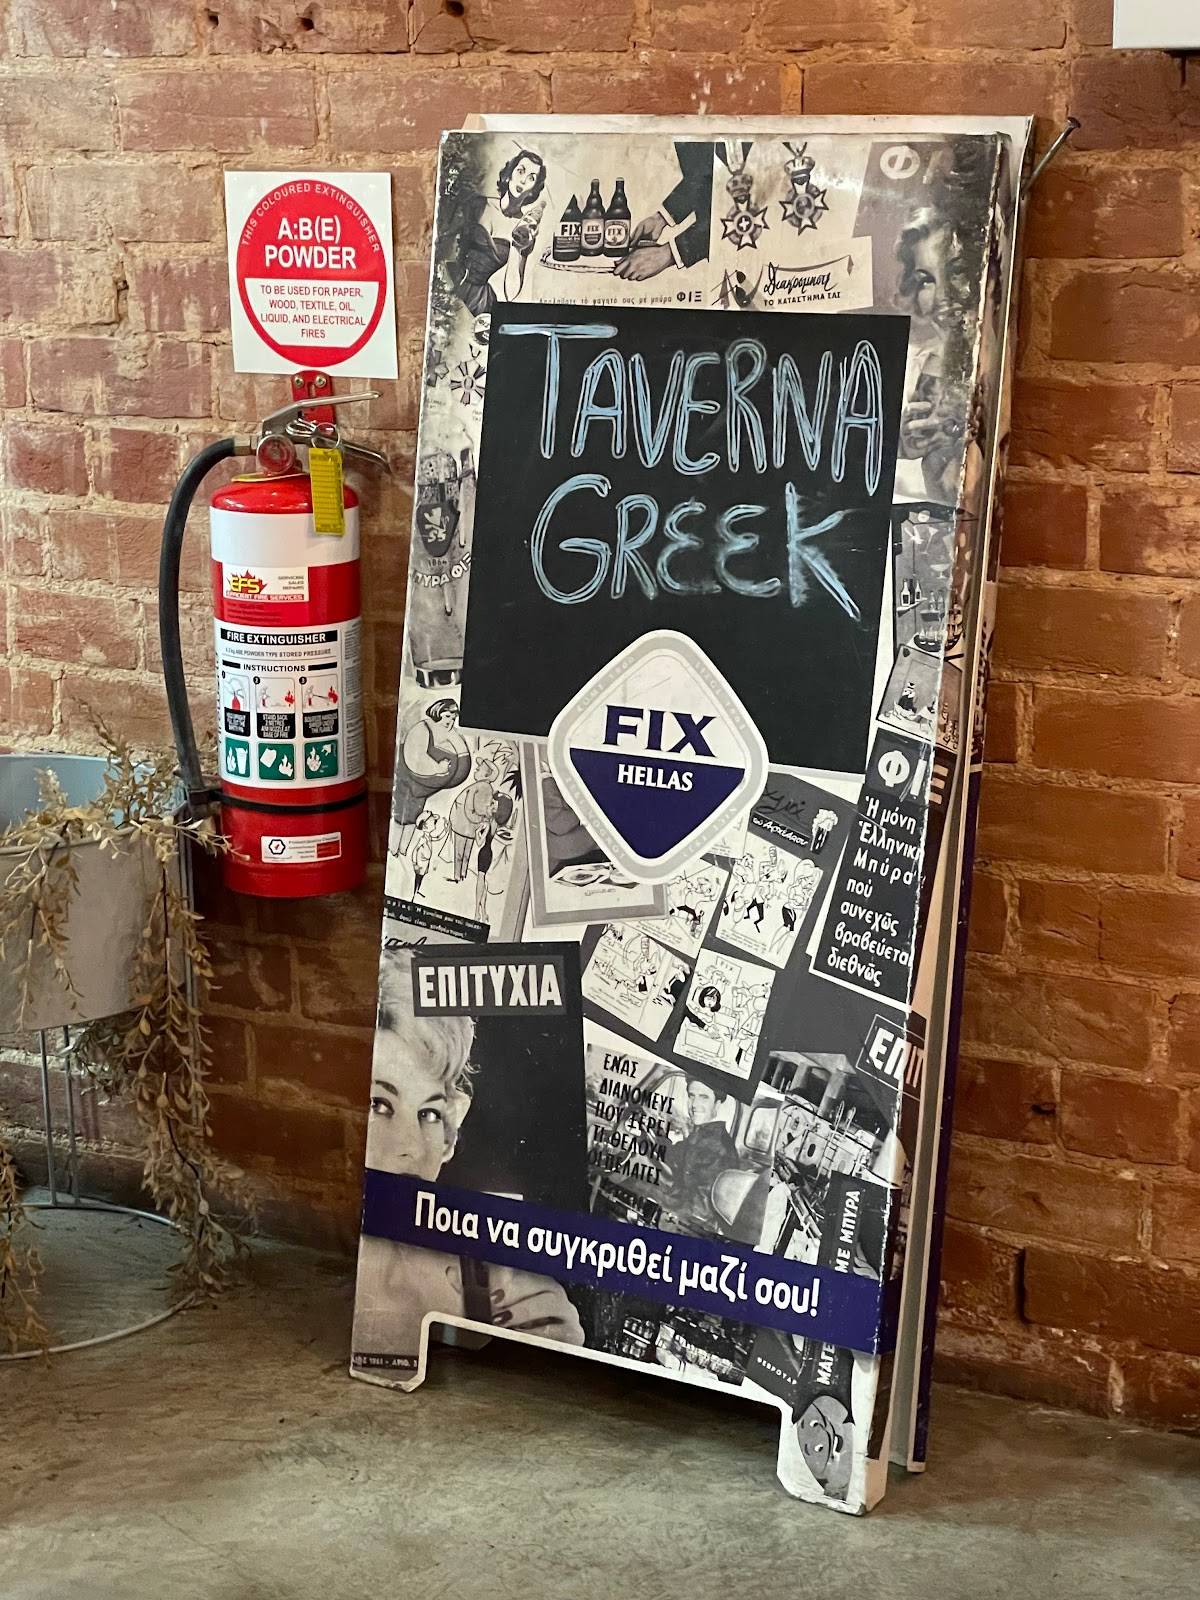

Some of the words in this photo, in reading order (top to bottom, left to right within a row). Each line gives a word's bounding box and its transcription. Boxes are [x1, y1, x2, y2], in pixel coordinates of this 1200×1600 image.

[241, 217, 258, 246] THIS
[256, 182, 311, 217] COLOURED
[315, 183, 380, 252] EXTINGUISHER
[277, 215, 341, 244] A:B(E)
[561, 224, 581, 236] FIX
[264, 244, 357, 270] POWDER
[261, 285, 272, 295] TO
[274, 285, 285, 295] BE
[287, 286, 310, 296] USED
[312, 286, 330, 296] FOR
[332, 287, 364, 298] PAPER,
[676, 290, 703, 303] ΦΙΞ
[269, 299, 298, 311] WOOD,
[301, 300, 337, 312] TEXTILE,
[261, 313, 291, 324] LIQUID,
[293, 314, 310, 324] AND
[312, 315, 366, 326] ELECTRICAL
[301, 328, 326, 339] FIRES
[499, 323, 882, 496] TAVERNA
[531, 473, 862, 621] GREEK
[230, 576, 260, 594] EFS
[226, 631, 245, 642] FIRE
[246, 632, 326, 645] EXTINGUISHER
[243, 663, 306, 673] INSTRUCTIONS
[603, 704, 717, 757] FIX
[617, 763, 693, 792] HELLAS
[880, 807, 916, 835] μόνη
[418, 964, 563, 1008] ΕΠΙΤΥΧΙΑ
[603, 1053, 639, 1079] ΕΝΑΣ
[599, 1077, 675, 1115] ΔΙΑΝΟΜΕΥΣ
[594, 1100, 624, 1124] ΠΟΥ
[611, 1131, 668, 1163] ΘΕΛΟΥΝ
[839, 1190, 860, 1244] ΜΠΥΡΑ
[414, 1190, 479, 1240] Ποια
[487, 1216, 520, 1249] να
[527, 1226, 672, 1282] συγκριθεί
[679, 1254, 748, 1303] μαζί
[755, 1278, 821, 1318] σου!
[834, 1247, 851, 1274] ΜΕ
